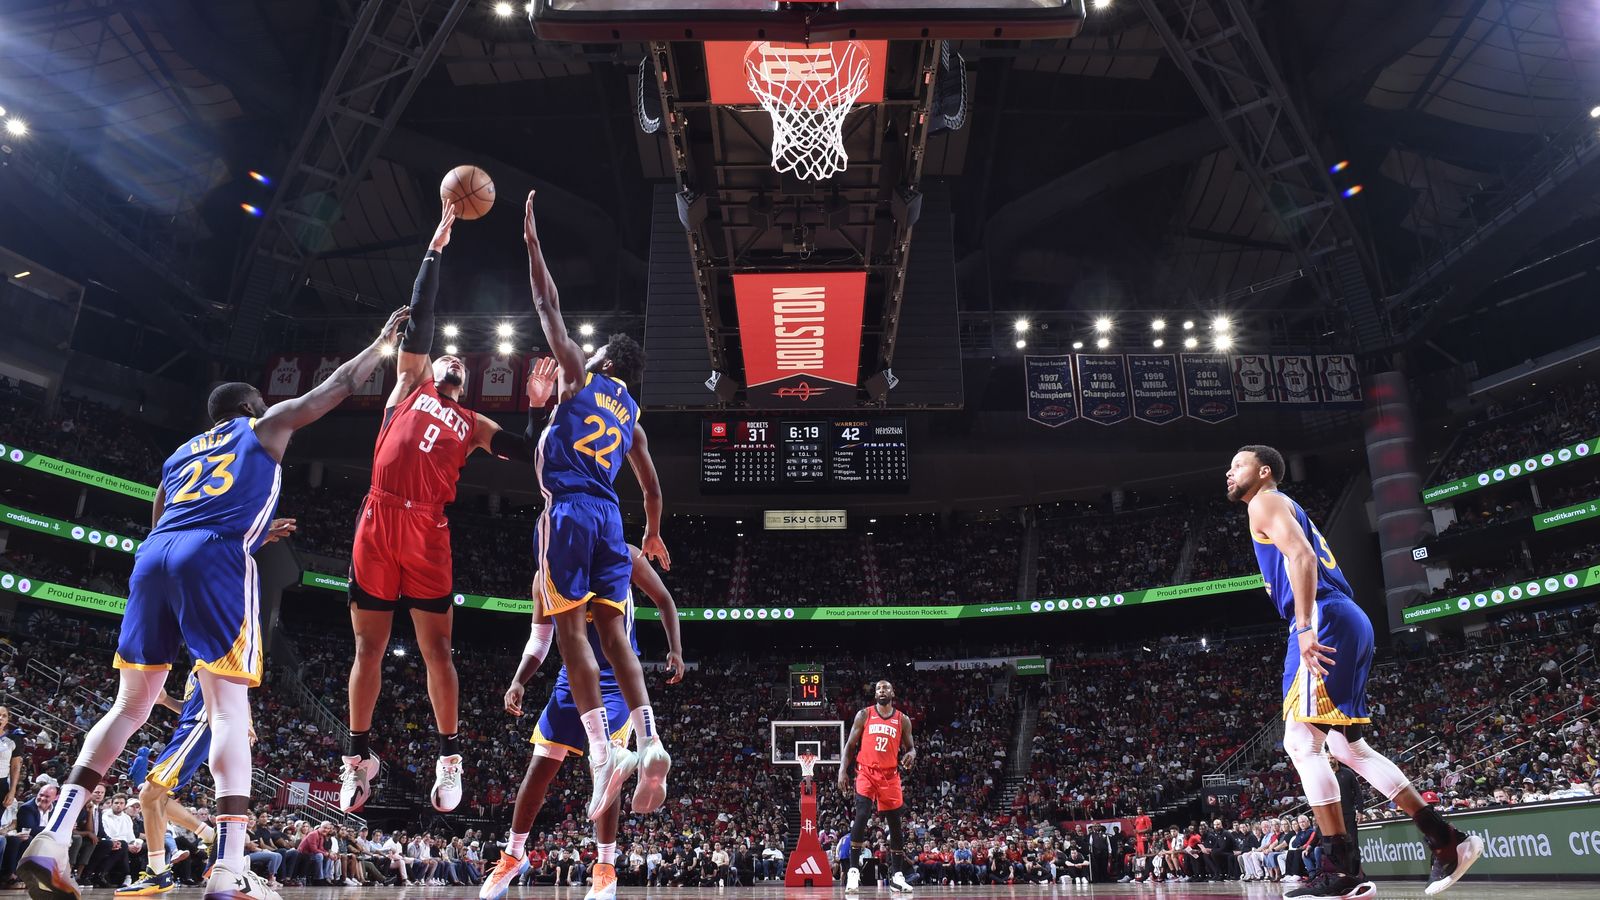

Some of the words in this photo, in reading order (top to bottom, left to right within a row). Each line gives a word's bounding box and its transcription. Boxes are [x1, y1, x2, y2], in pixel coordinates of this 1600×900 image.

[772, 287, 825, 369] HOUSTON
[491, 373, 504, 384] 34
[1030, 391, 1072, 400] Champions
[1083, 390, 1126, 399] Champions
[1135, 389, 1176, 398] Champions
[1188, 388, 1231, 397] Champions
[594, 392, 630, 425] WIGGINS
[411, 394, 469, 441] ROCKETS
[418, 424, 440, 453] 9
[749, 429, 765, 441] 31
[790, 427, 819, 438] 6:19
[842, 428, 860, 440] 42
[573, 415, 622, 469] 22
[39, 459, 63, 472] Proud
[65, 467, 94, 481] partner
[105, 479, 118, 487] the
[120, 482, 150, 496] Houston
[172, 453, 236, 504] 23
[1425, 484, 1458, 499] creditkarma
[7, 512, 49, 528] creditkarma
[1544, 508, 1586, 524] creditkarma
[1179, 588, 1203, 596] partner
[1228, 579, 1258, 587] Houston
[48, 587, 73, 600] Proud
[75, 594, 108, 606] partner
[497, 600, 516, 609] Proud
[848, 610, 869, 618] partner
[872, 608, 879, 616] of
[880, 608, 890, 616] the
[892, 608, 919, 616] Houston
[921, 608, 948, 616] Rockets.
[1405, 606, 1441, 619] creditkarma
[800, 675, 819, 684] 6:19
[804, 686, 816, 698] 14
[869, 724, 897, 738] ROCKETS
[875, 737, 888, 752] 32
[1467, 829, 1552, 858] tkarma
